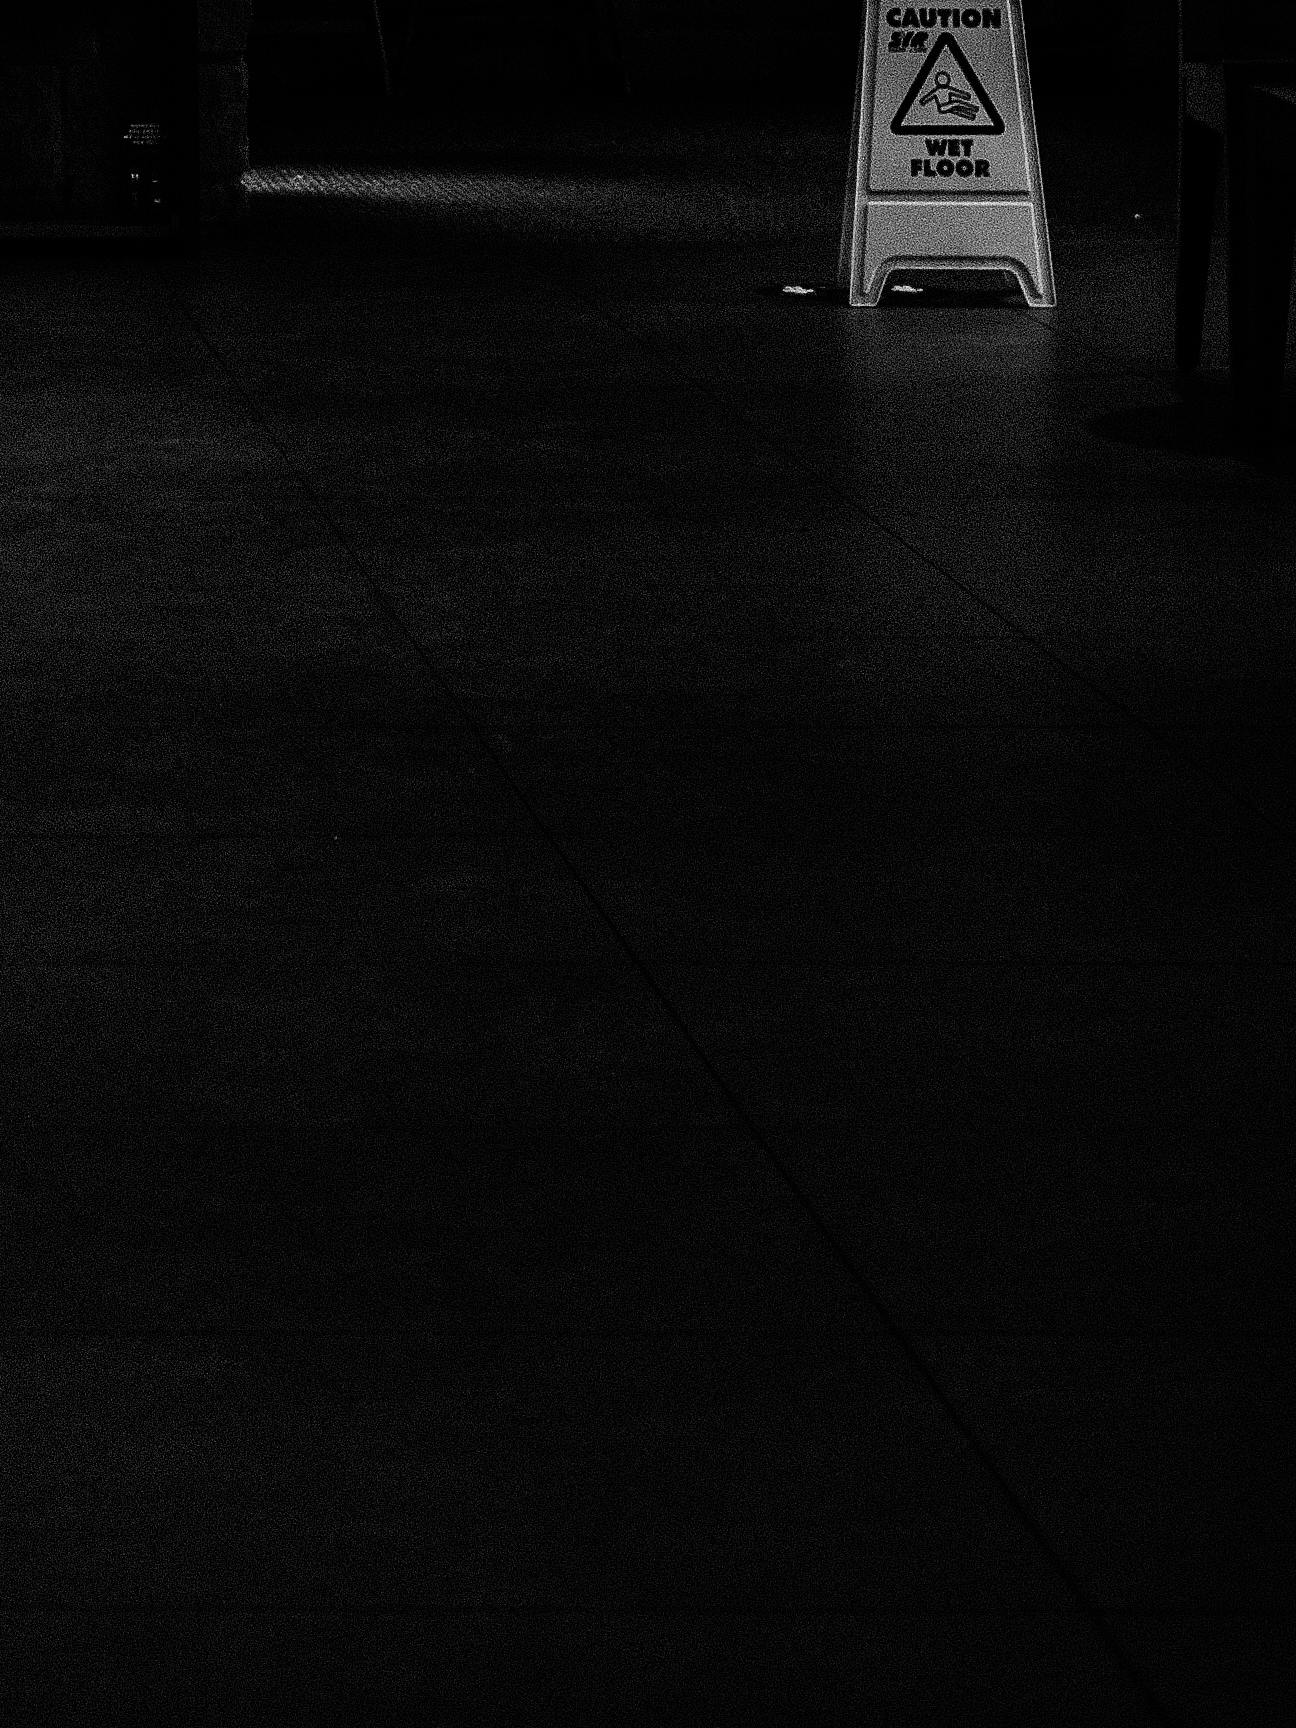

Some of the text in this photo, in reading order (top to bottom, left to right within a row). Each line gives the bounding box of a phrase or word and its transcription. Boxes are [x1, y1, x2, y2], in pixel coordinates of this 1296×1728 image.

[885, 7, 1002, 30] CAUTION
[924, 138, 974, 158] WET
[910, 159, 991, 179] FLOOR
